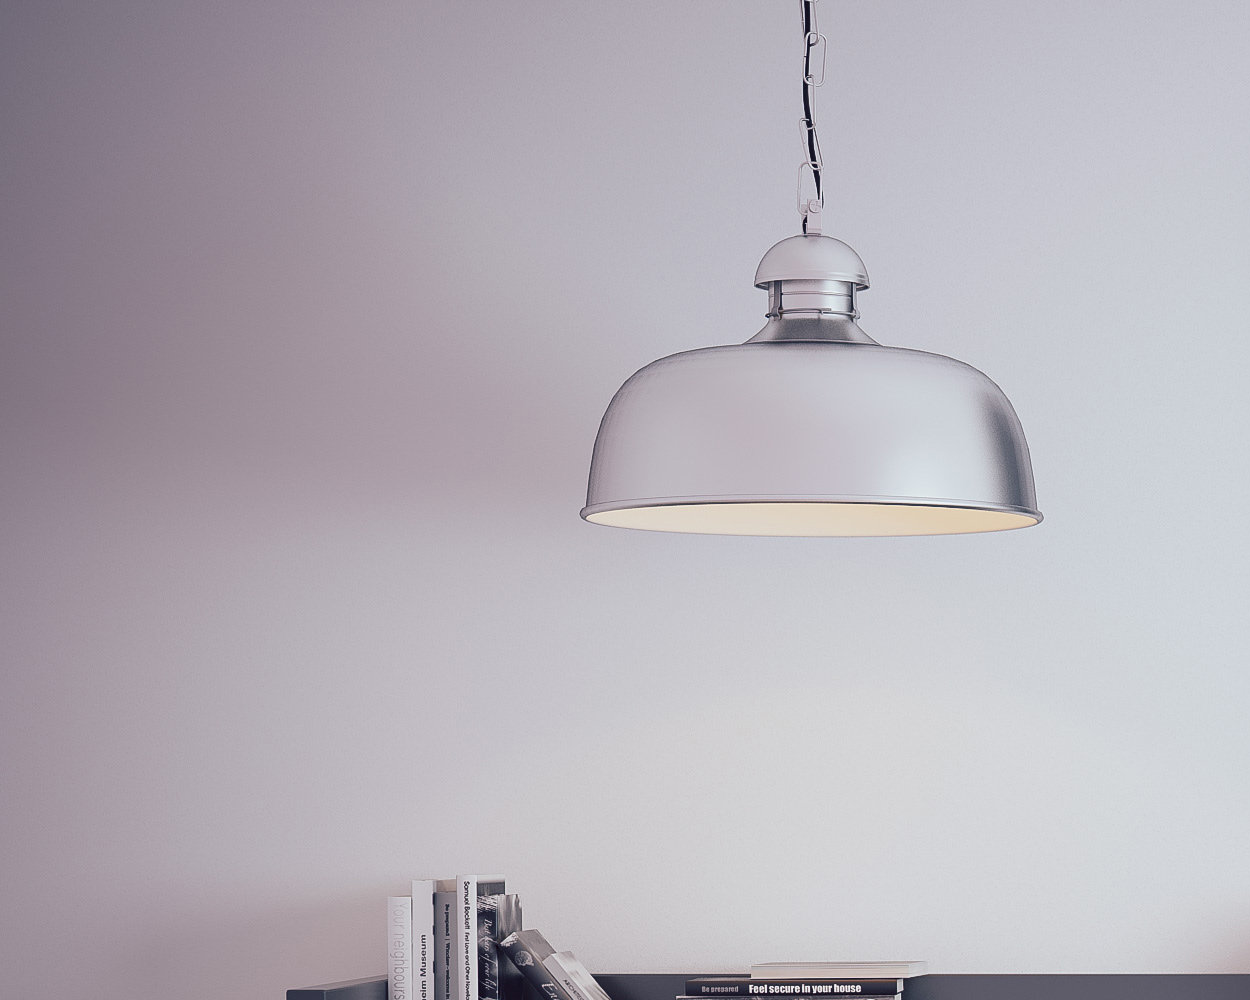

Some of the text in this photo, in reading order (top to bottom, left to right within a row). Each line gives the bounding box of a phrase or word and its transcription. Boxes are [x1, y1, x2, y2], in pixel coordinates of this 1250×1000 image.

[463, 881, 471, 906] Samuel
[463, 907, 471, 930] Beckett
[390, 903, 409, 1000] Your neighbours
[419, 934, 427, 977] Museum
[463, 955, 471, 965] and
[748, 984, 862, 993] Feel secure in your house
